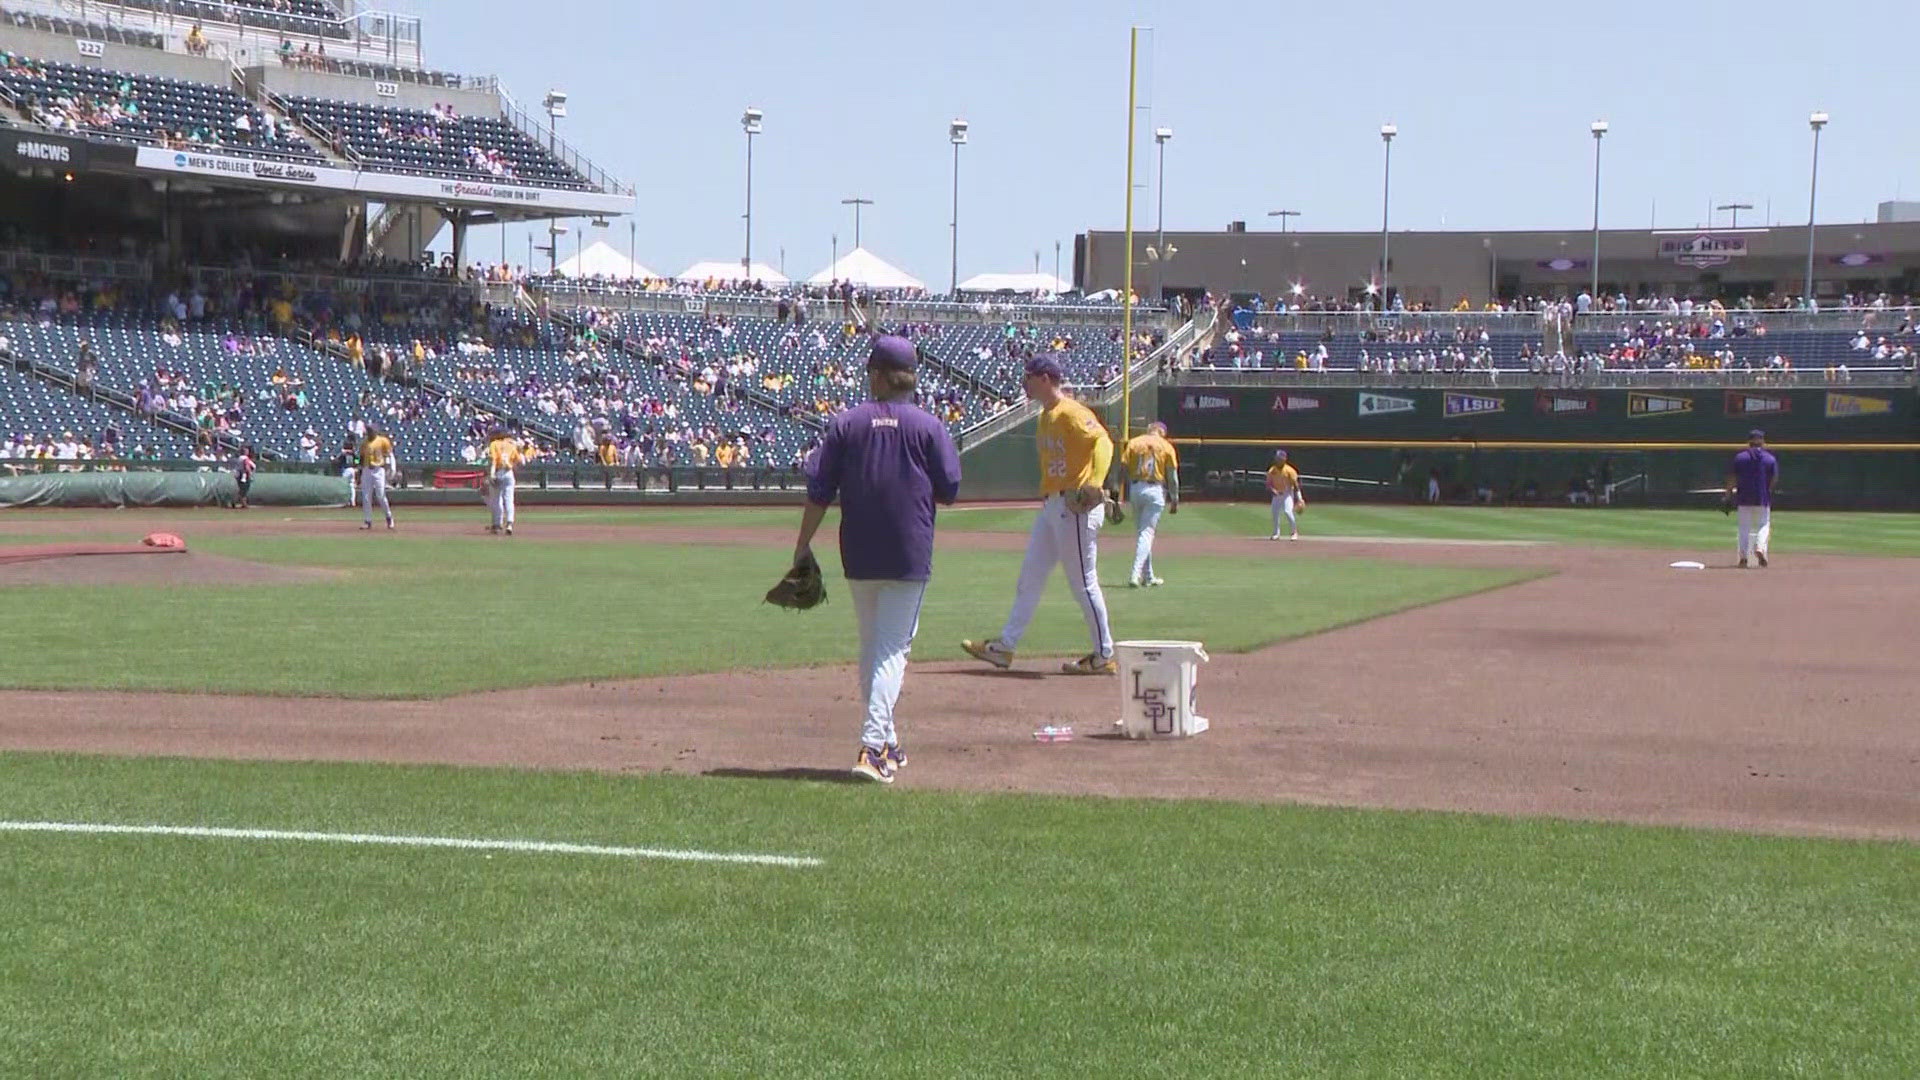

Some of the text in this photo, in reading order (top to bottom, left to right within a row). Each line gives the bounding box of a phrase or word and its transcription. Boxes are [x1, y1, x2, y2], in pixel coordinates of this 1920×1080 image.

[80, 43, 102, 56] 222
[378, 83, 397, 95] 223
[17, 142, 70, 162] #MCWS
[188, 157, 215, 170] MEN'S
[216, 161, 251, 174] COLLEGE
[253, 162, 284, 176] World
[286, 165, 316, 180] Series
[440, 182, 540, 202] THE Greatest SHOW ON DIRT
[1664, 241, 1694, 252] BIG
[687, 301, 704, 310] 123
[1013, 312, 1029, 321] 124
[1378, 319, 1395, 327] 125
[1462, 398, 1495, 412] LSU
